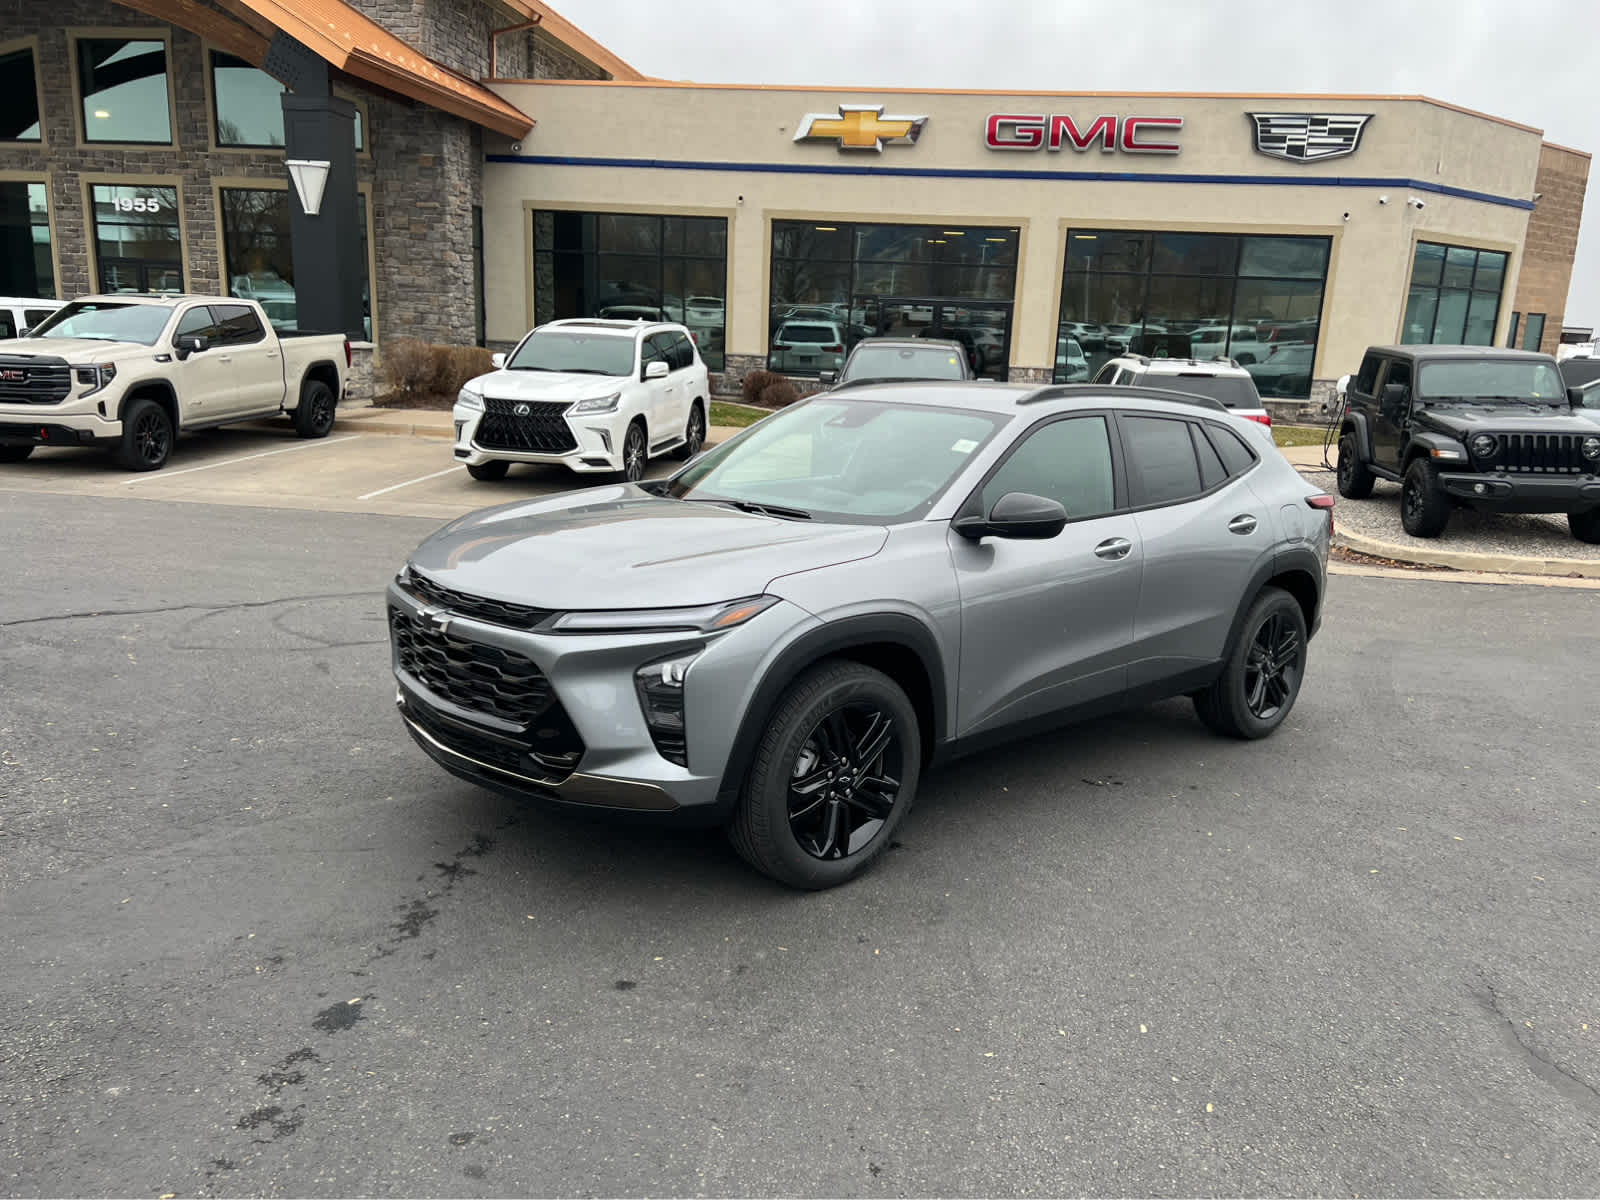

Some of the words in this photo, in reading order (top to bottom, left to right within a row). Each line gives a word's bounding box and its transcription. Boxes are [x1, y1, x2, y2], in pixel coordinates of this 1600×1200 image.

[985, 113, 1184, 155] GMC
[111, 197, 160, 213] 1955
[0, 369, 24, 380] MC
